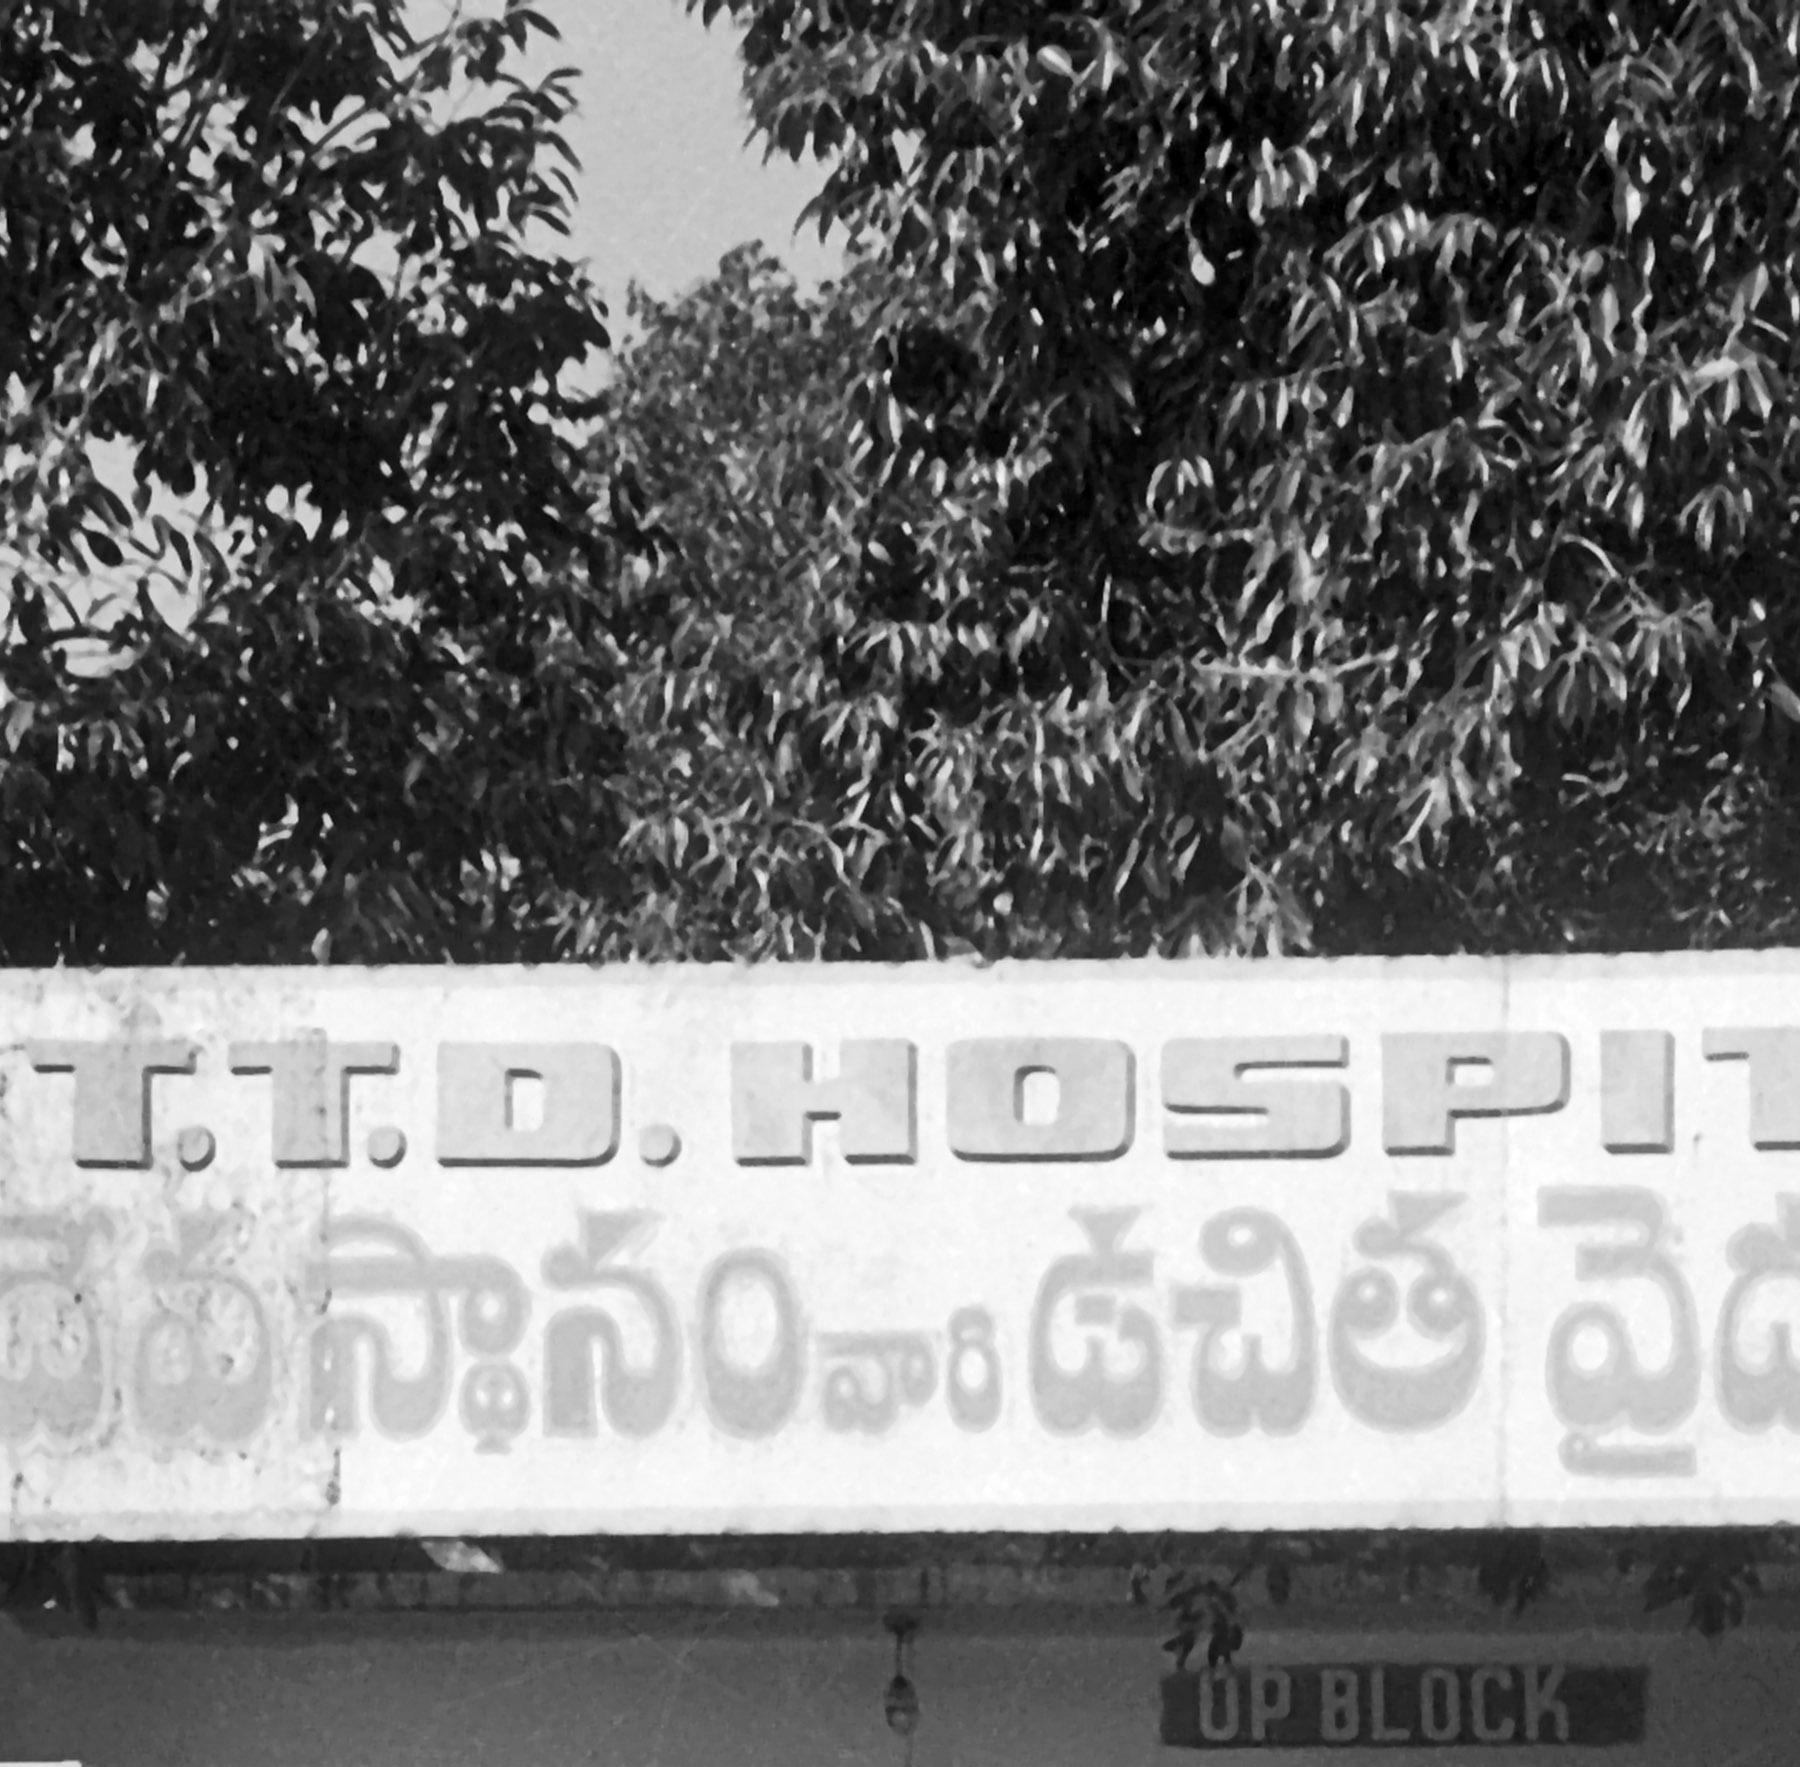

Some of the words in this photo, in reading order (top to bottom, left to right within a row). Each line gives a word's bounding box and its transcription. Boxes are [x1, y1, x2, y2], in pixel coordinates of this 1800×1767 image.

[26, 1038, 683, 1172] T.T.D.
[1028, 1188, 1489, 1442] ఉచిత
[1200, 1664, 1292, 1742] OP
[1319, 1664, 1570, 1743] BLOCK
